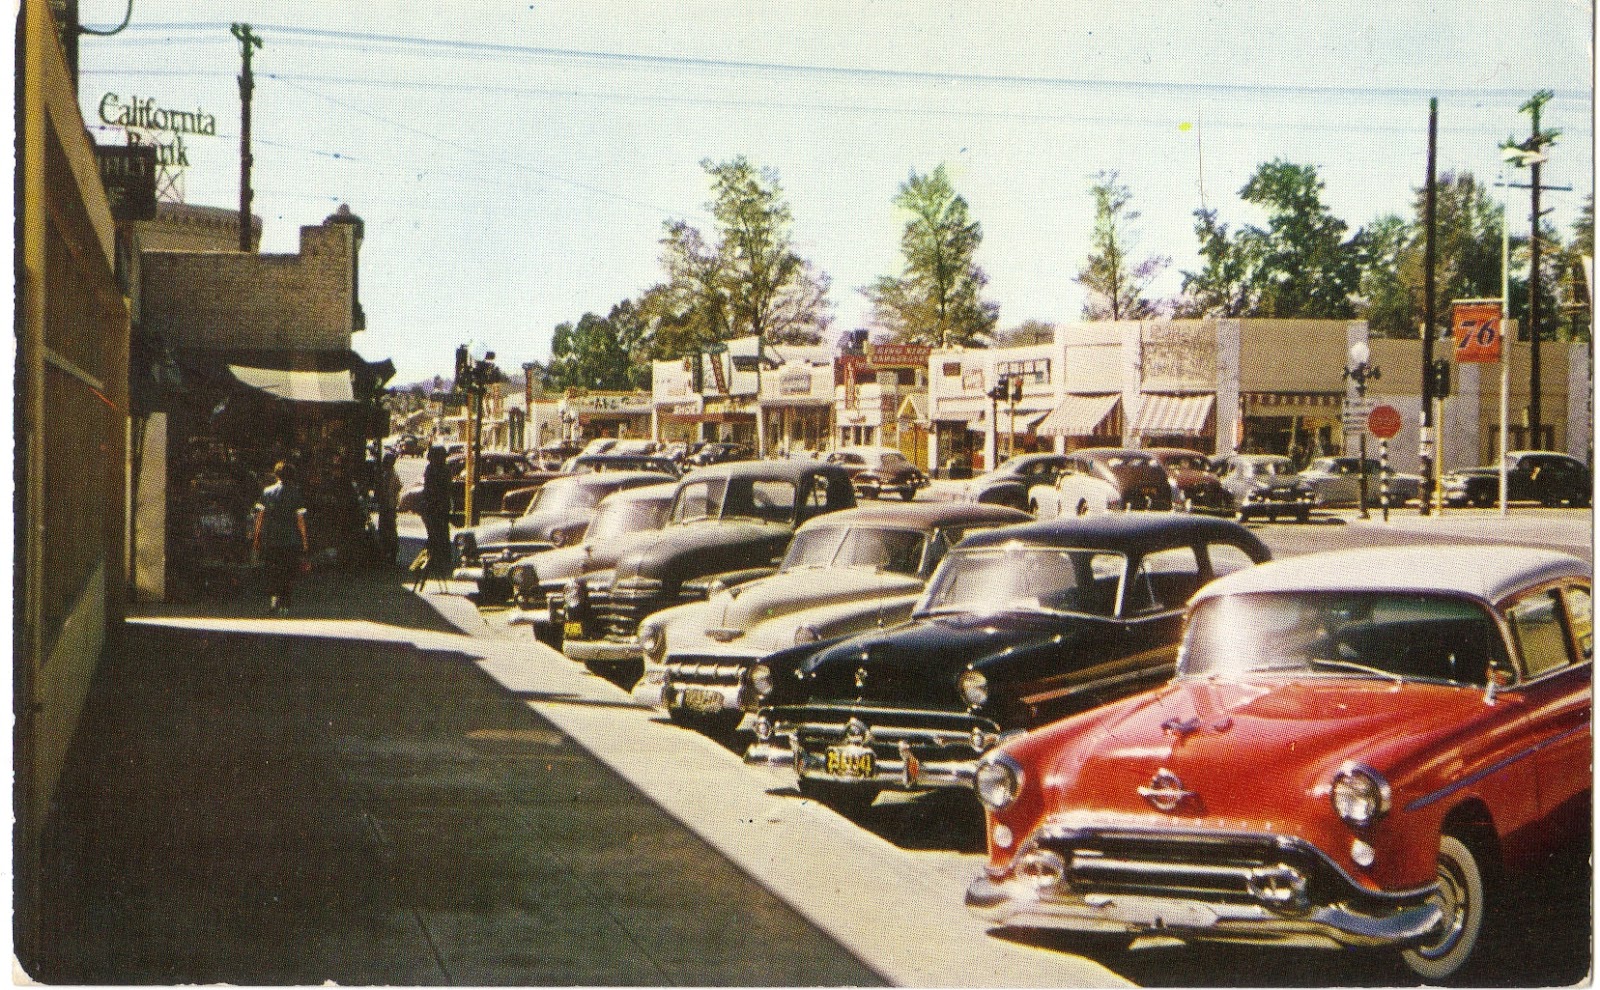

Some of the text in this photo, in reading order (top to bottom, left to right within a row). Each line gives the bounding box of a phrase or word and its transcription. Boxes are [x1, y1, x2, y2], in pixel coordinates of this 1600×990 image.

[98, 91, 217, 136] California
[127, 132, 190, 167] Bnk
[1459, 318, 1496, 349] 76
